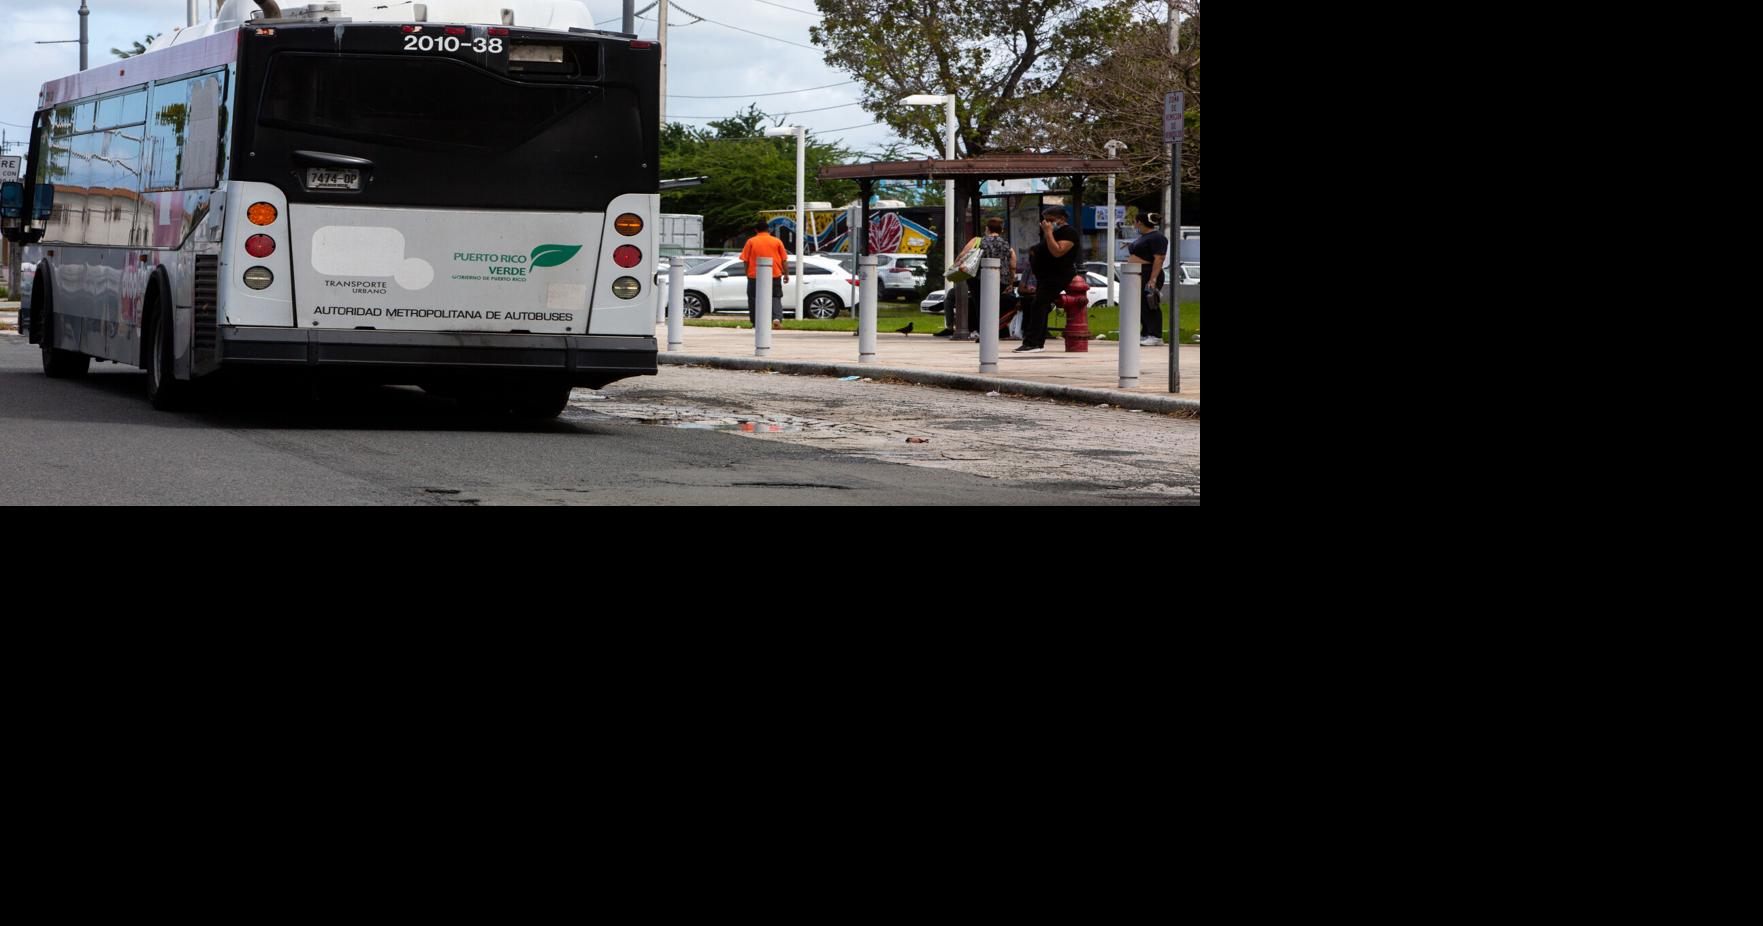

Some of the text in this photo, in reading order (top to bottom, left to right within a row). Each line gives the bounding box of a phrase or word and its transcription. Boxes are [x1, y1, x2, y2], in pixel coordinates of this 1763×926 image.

[403, 35, 503, 53] 2010-38
[453, 252, 527, 264] PUERTO RICO
[489, 266, 526, 276] VERDE
[325, 279, 388, 288] TRANSPORTE
[314, 306, 573, 322] AUTORIDAD METROPOLITANA DE AUTOBUSES
